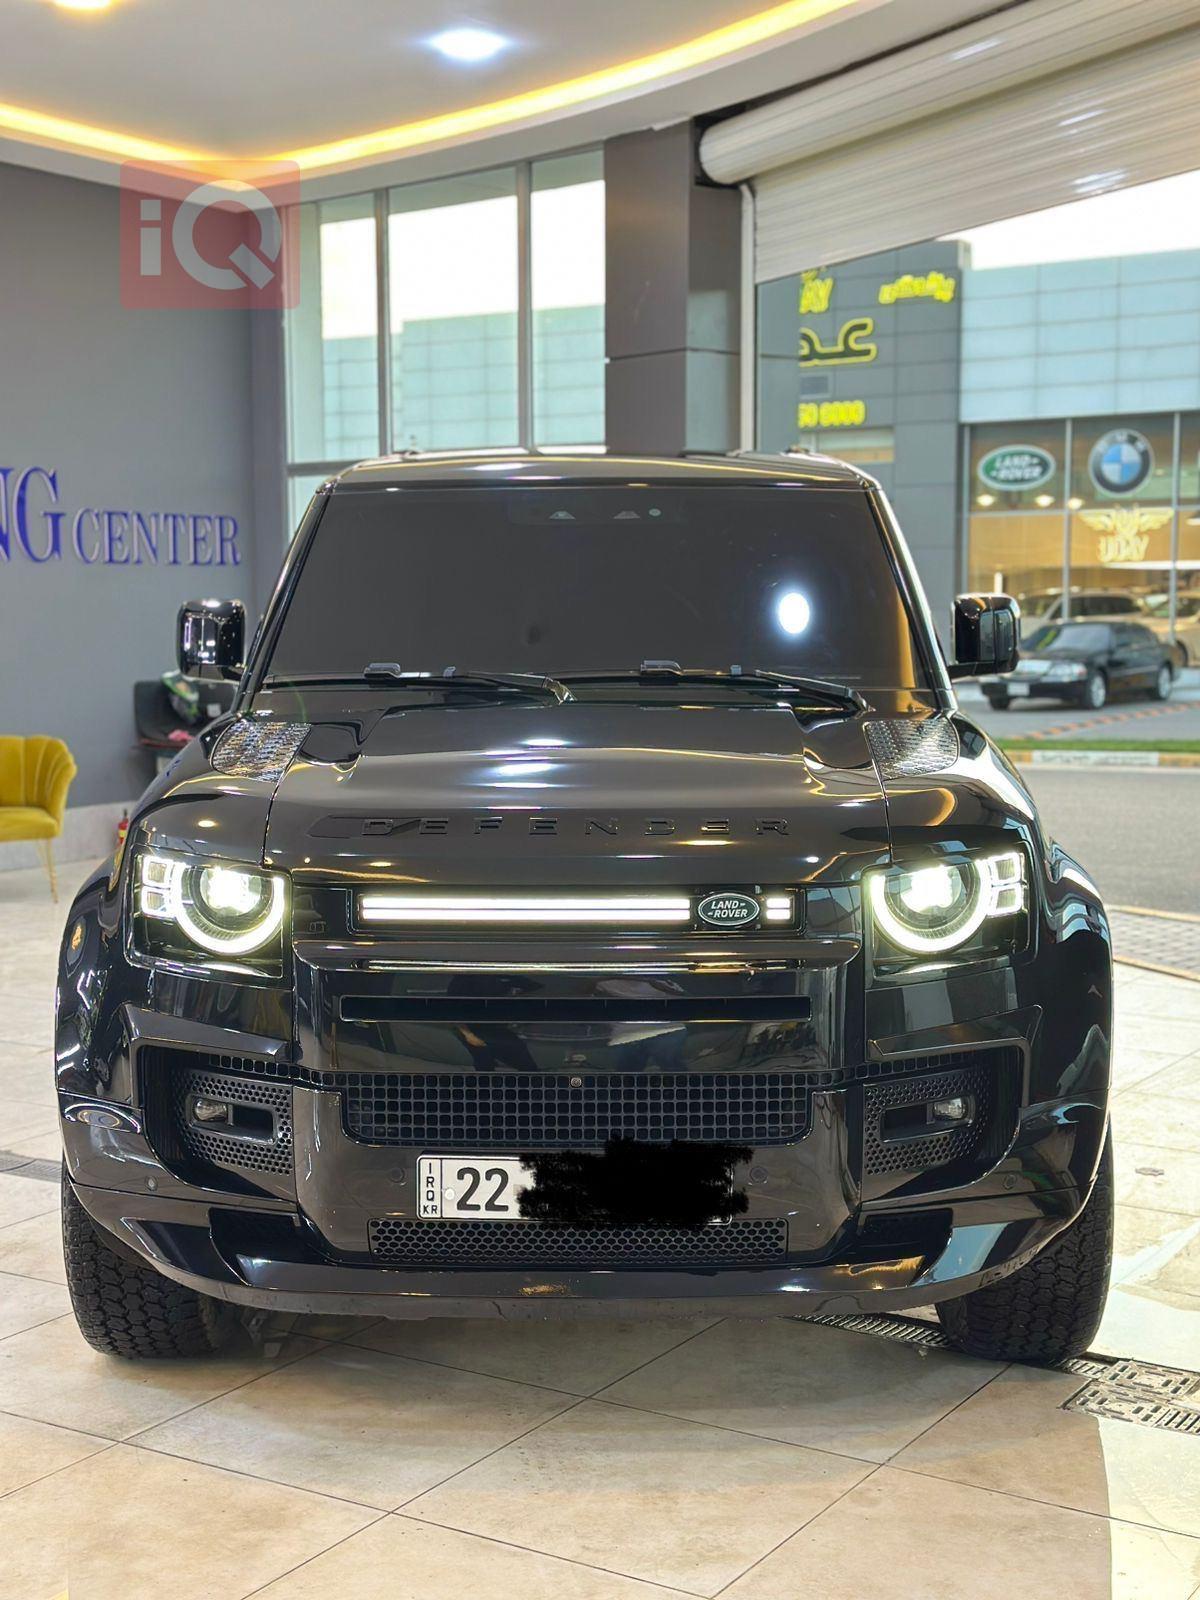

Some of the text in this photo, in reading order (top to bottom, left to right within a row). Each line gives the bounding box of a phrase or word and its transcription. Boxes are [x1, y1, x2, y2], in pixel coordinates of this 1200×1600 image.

[73, 508, 241, 566] CENTER
[362, 816, 790, 836] DEFENDER
[456, 1166, 510, 1212] 22
